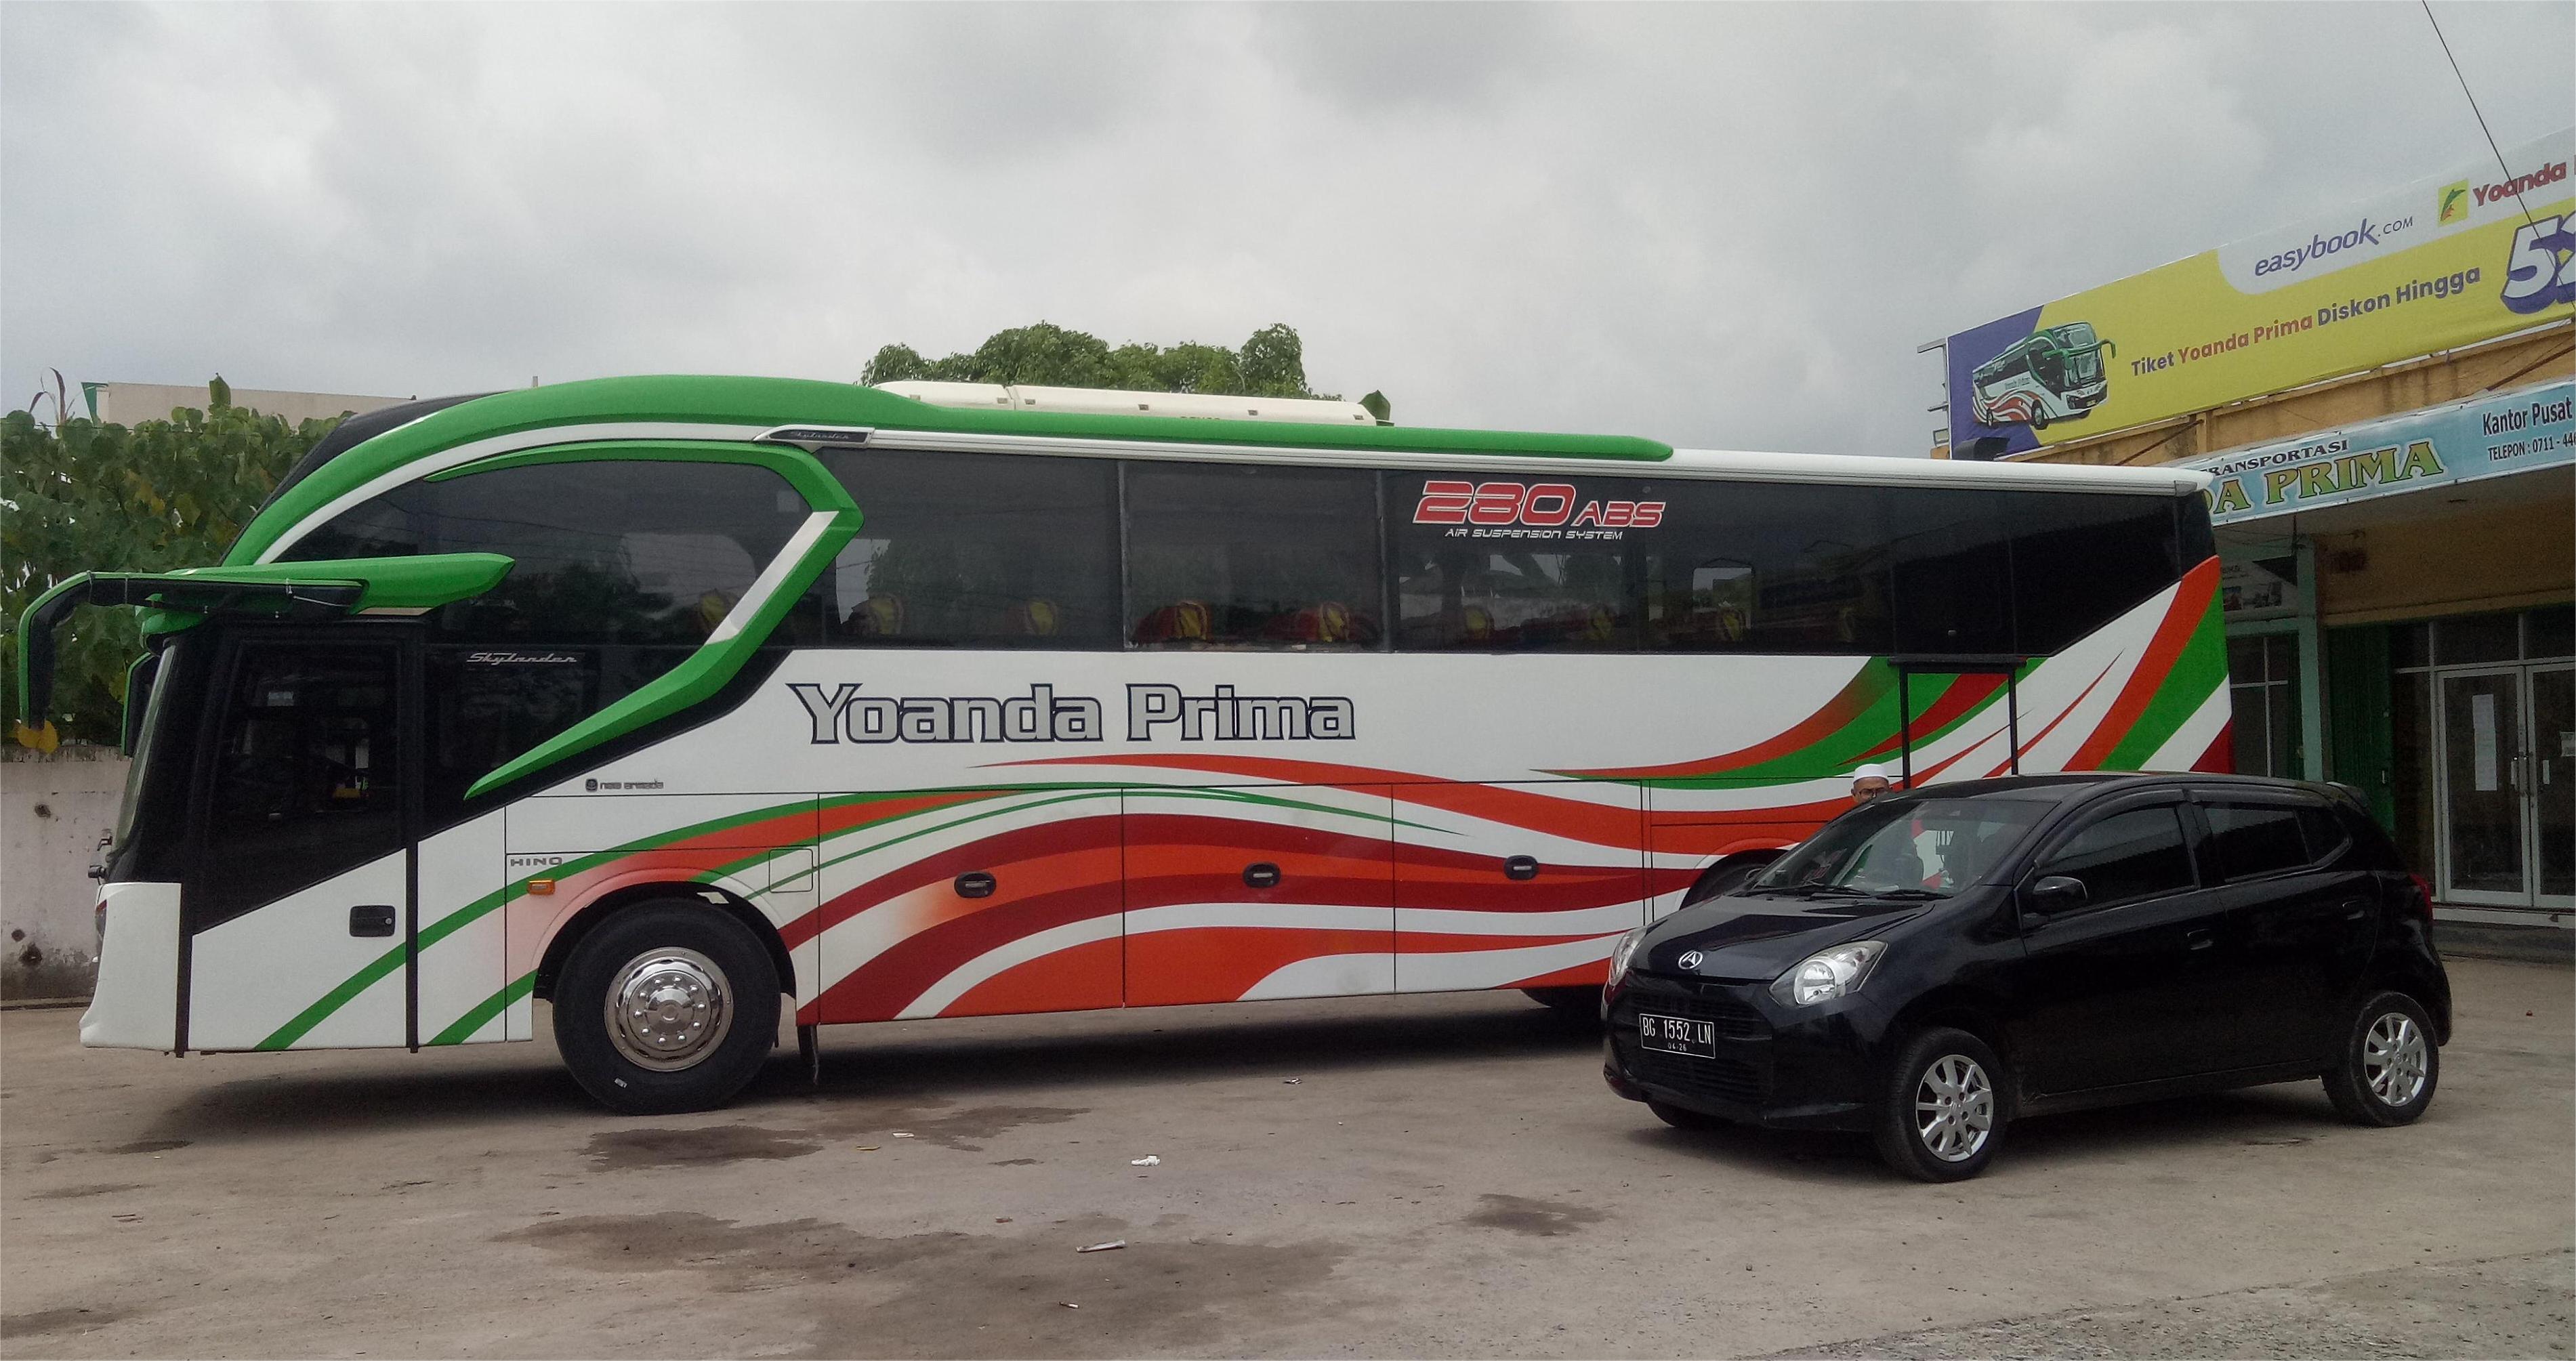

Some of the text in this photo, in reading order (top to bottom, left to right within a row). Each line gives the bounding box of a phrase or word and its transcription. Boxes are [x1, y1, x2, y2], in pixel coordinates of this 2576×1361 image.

[2473, 162, 2567, 206] Yoanda
[2132, 267, 2480, 376] Tiket Yoanda Prima Diskon Hingga
[2482, 396, 2573, 436] Kantor Pusat
[2200, 440, 2348, 476] RANSPORTASI
[2487, 441, 2526, 461] TELEPON
[2533, 436, 2554, 453] 0711
[2264, 441, 2444, 504] PRIMA
[1413, 480, 1666, 527] 280 ABS
[1565, 530, 1623, 540] SYSTEM
[467, 652, 577, 665] Skylander
[785, 683, 1356, 745] Yoanda Prima
[510, 857, 562, 866] HINO
[1642, 1017, 1711, 1045] BG 1552 LN
